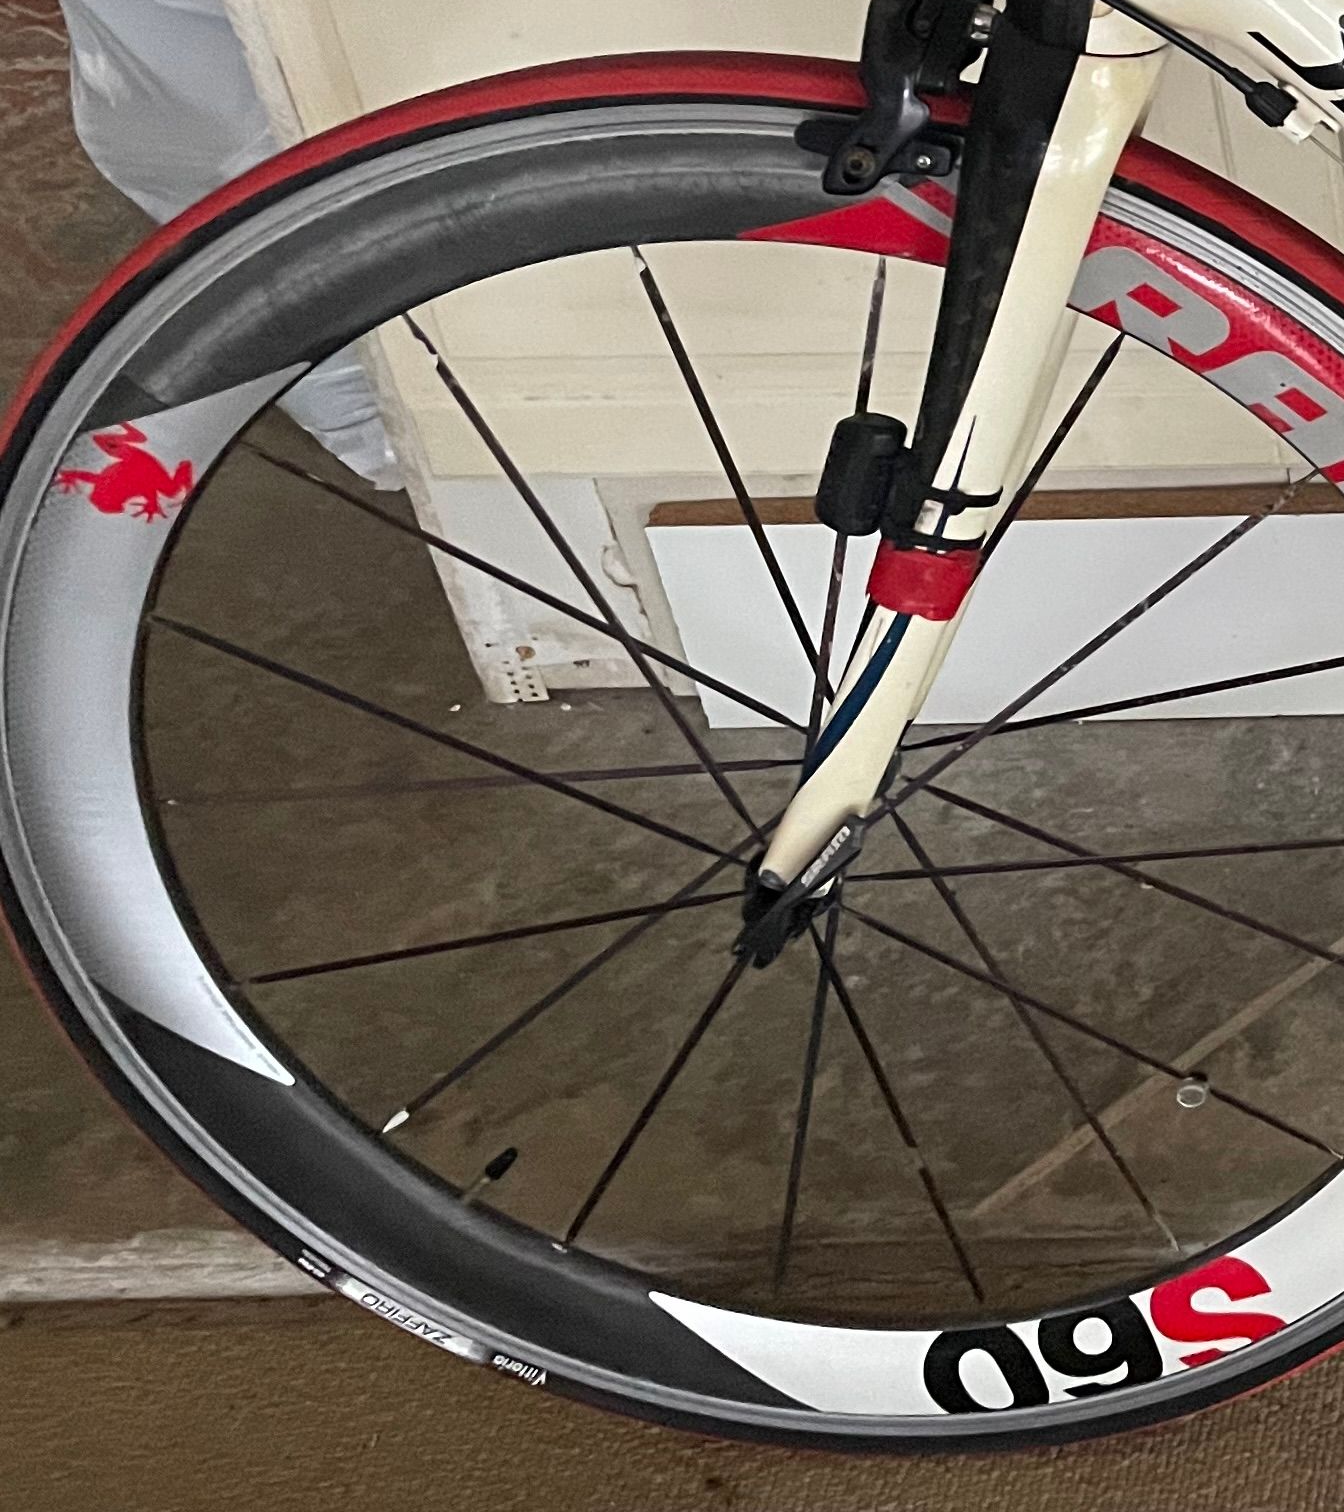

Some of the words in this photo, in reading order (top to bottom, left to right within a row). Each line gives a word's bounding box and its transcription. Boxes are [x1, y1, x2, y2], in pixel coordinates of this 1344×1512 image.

[800, 825, 851, 888] SRAM
[360, 1292, 454, 1345] ZAFFIRO
[923, 1254, 1288, 1415] S60
[492, 1353, 547, 1386] Vittoria
